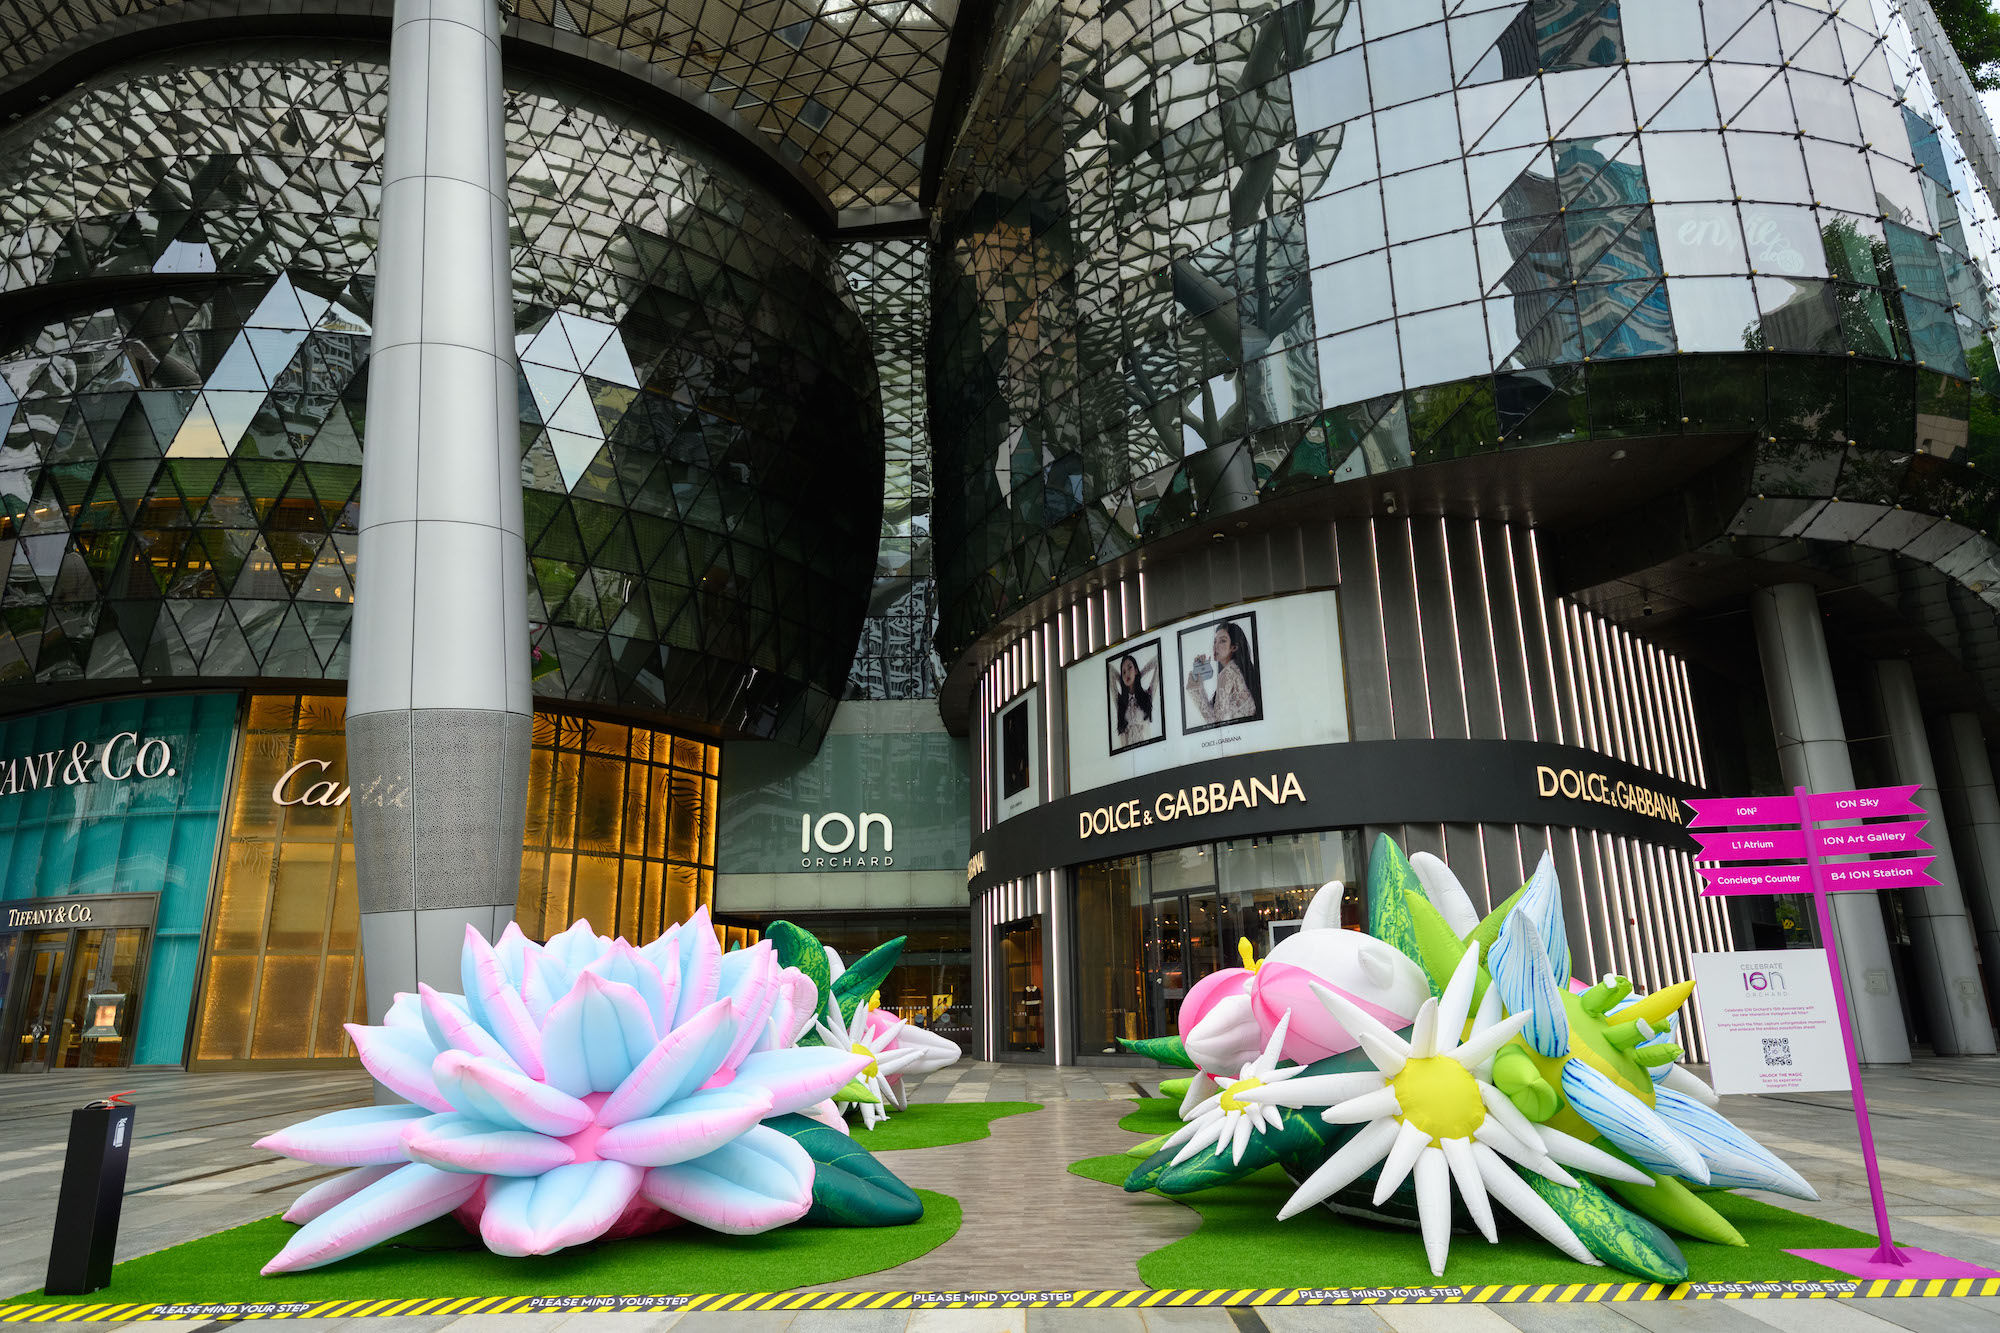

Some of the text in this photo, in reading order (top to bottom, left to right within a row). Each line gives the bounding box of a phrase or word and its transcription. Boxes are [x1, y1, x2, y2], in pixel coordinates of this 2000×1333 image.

[1537, 766, 1611, 806] DOLCE
[1616, 780, 1682, 825] GABBANA
[1079, 799, 1141, 839] DOLCE
[1155, 772, 1307, 822] GABBANA
[1836, 798, 1879, 808] ION Sky
[1823, 833, 1906, 845] ION Art Gallery
[1732, 841, 1774, 849] L1 Atrium
[801, 856, 893, 868] ORCHARD
[1831, 868, 1913, 880] B4 ION Station
[1717, 875, 1800, 885] Concierge Counter
[1692, 1283, 1858, 1293] PLEASE MIND YOUR STEP
[912, 1293, 1072, 1302] PLEASE MIND YOUR STEP
[1300, 1288, 1462, 1299] PLEASE MIND YOUR STEP
[530, 1297, 688, 1307] PLEASE MIND YOUR STEP
[152, 1304, 310, 1314] PLEASE MIND YOUR STEP
